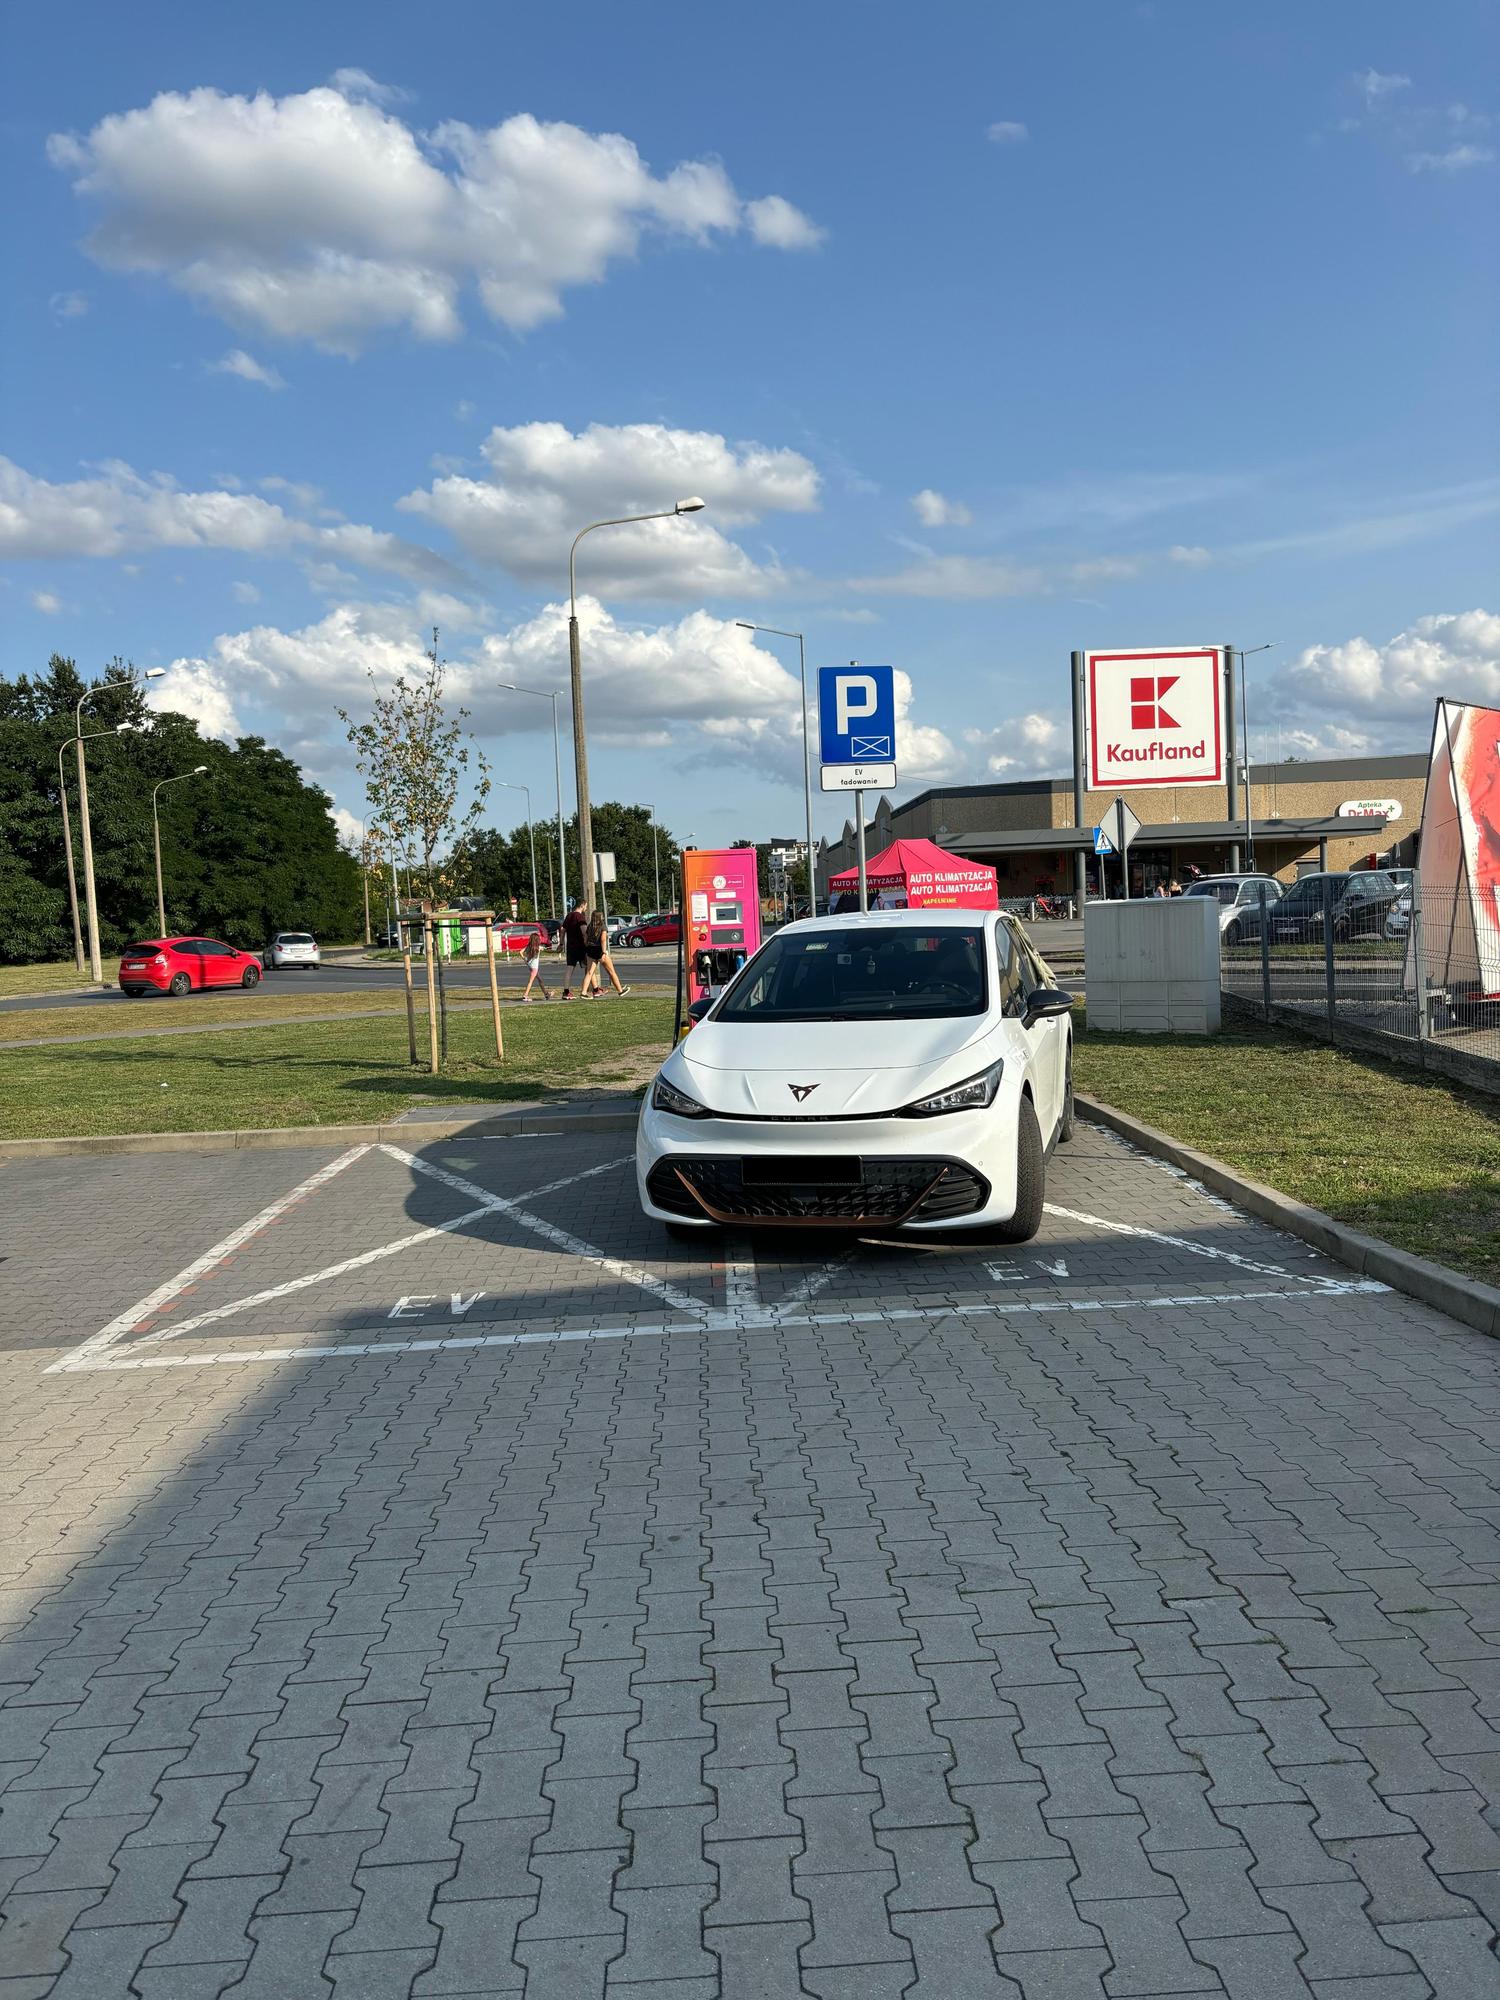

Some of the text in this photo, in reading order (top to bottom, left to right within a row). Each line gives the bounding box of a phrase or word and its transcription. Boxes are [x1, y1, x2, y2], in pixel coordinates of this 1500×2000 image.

[835, 675, 878, 735] P
[1107, 740, 1206, 763] Kaufland
[840, 778, 878, 786] ładowanie
[852, 876, 904, 886] KATYZACJA
[909, 870, 993, 883] AUTO KLIMATYZACJA
[910, 885, 933, 896] AUTO
[935, 881, 993, 894] KLIMATYZACJA
[982, 1259, 1069, 1281] EV
[387, 1291, 487, 1319] EV
